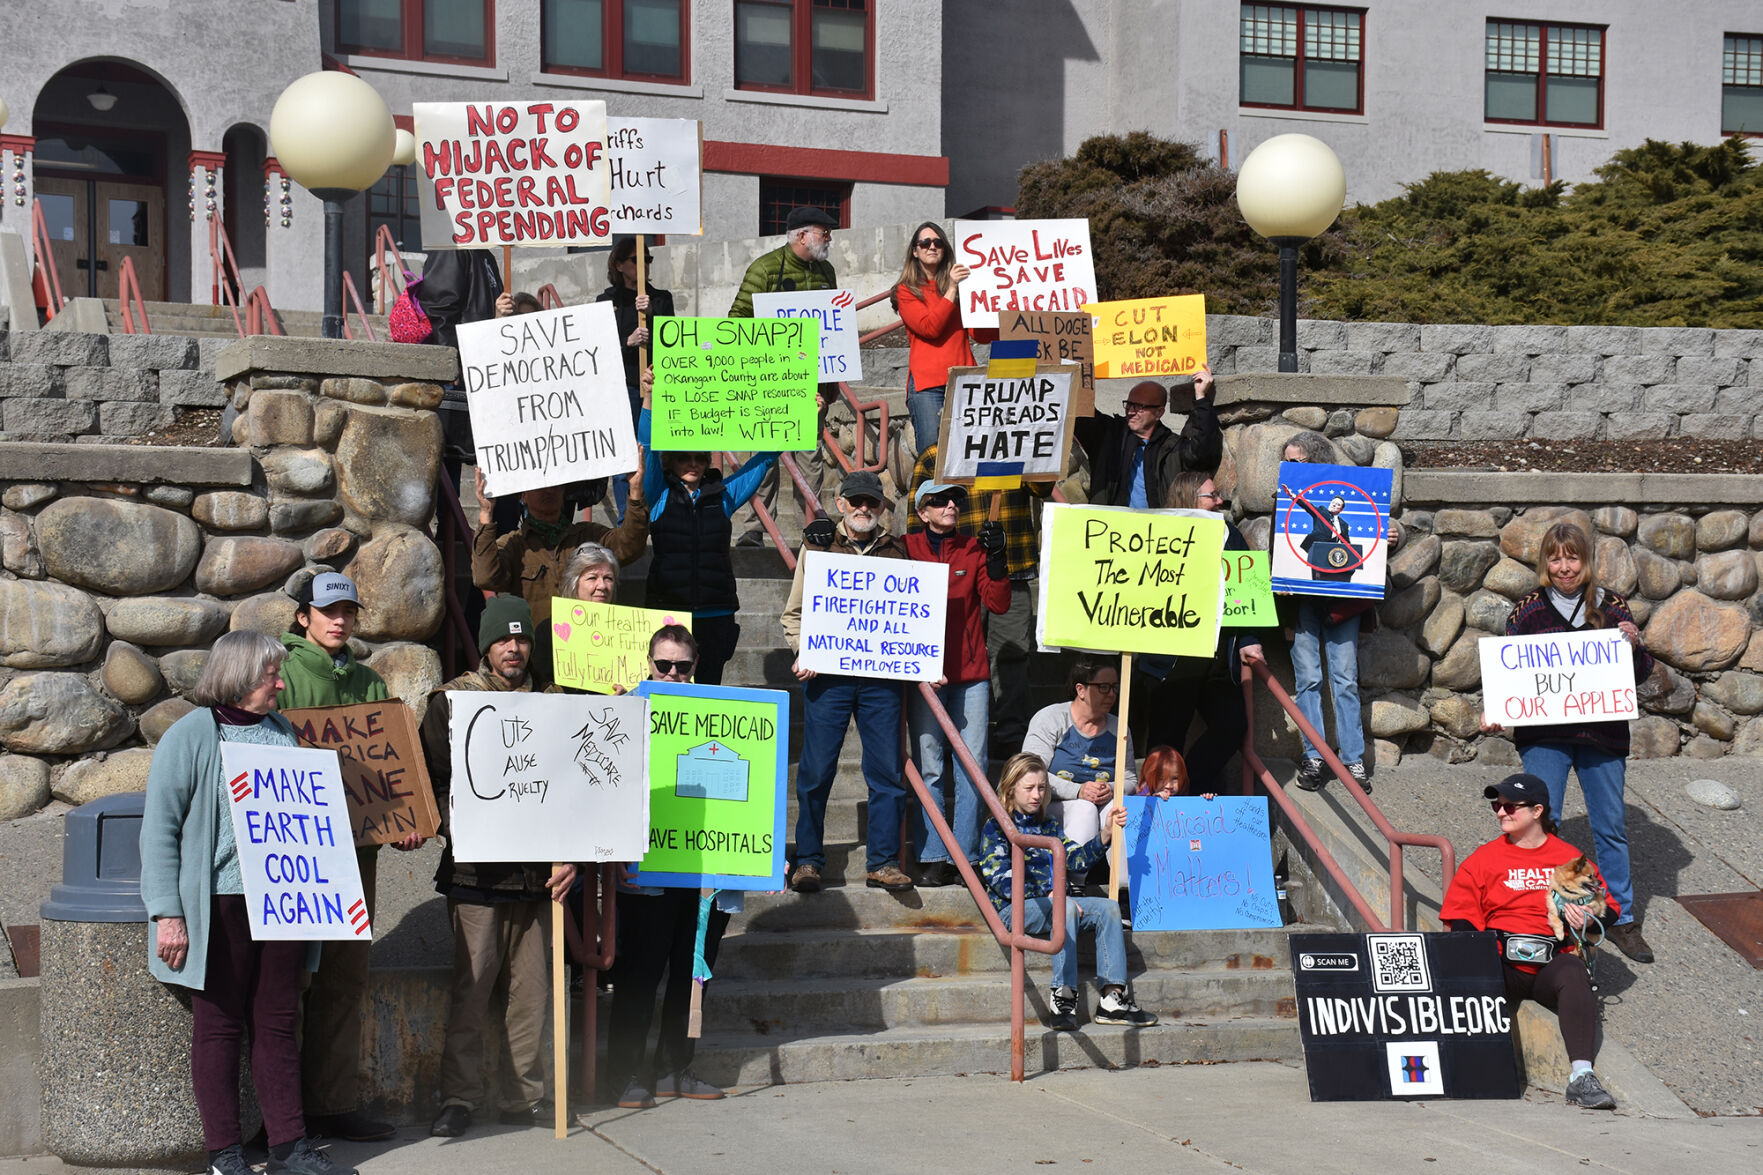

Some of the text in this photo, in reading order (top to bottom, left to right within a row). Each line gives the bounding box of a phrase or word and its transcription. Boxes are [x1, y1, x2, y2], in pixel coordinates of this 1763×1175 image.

[466, 103, 580, 137] NO TO
[607, 128, 644, 149] riffs
[423, 138, 603, 179] HIJACK OF
[609, 157, 666, 190] Hurt
[434, 174, 589, 211] FEDERAL
[452, 206, 610, 244] SPENDING
[611, 204, 672, 221] rchards
[993, 262, 1065, 290] SAVE
[1011, 313, 1090, 335] ALL DOGE
[1115, 305, 1168, 327] CUT
[500, 315, 580, 356] SAVE
[659, 319, 698, 348] OH
[716, 320, 803, 348] SNAP?!
[1112, 325, 1178, 346] ELON
[661, 352, 791, 369] OVER 9,000 people in
[1059, 338, 1084, 360] BE
[1135, 345, 1166, 358] NOT
[467, 346, 598, 393] DEMOCRACY
[720, 369, 757, 387] County
[760, 373, 779, 382] are
[781, 369, 810, 381] about
[1121, 356, 1196, 375] MEDICAID
[517, 389, 584, 423] FROM
[662, 388, 807, 403] to LOSE SNAP resources
[962, 378, 1055, 406] TRUMP
[668, 409, 681, 420] IF
[690, 407, 736, 423] Budget
[739, 407, 751, 417] is
[963, 403, 1060, 427] SPREADS
[670, 420, 801, 442] into law! WTF?!
[964, 430, 1055, 460] HATE
[478, 424, 616, 476] TRUMP/PUTIN
[326, 582, 350, 591] SINIXT
[827, 568, 920, 594] KEEP OUR
[1095, 558, 1185, 587] The Most
[571, 604, 600, 627] Our
[813, 595, 930, 618] FIREFIGHTERS
[1077, 591, 1201, 629] Vulnerable
[847, 617, 911, 635] AND ALL
[591, 631, 649, 651] Our Futur
[808, 635, 940, 658] NATURAL RESOURCE
[556, 648, 585, 687] Fully
[587, 653, 613, 683] Fund
[839, 657, 921, 674] EMPLOYEES
[1501, 642, 1563, 670] CHINA
[1535, 672, 1576, 695] BUY
[1505, 688, 1634, 720] OUR APPLES
[291, 711, 384, 746] MAKE
[589, 707, 630, 755] SAVE
[650, 711, 774, 741] SAVE MEDICAID
[340, 741, 400, 766] RICA
[571, 723, 622, 787] MEDICARE
[254, 768, 329, 807] MAKE
[342, 768, 414, 807] ANE
[246, 811, 335, 847] EARTH
[1147, 799, 1235, 846] Medicaid
[649, 828, 772, 854] AVE HOSPITALS
[265, 853, 329, 884] COOL
[1154, 847, 1254, 900] Matters!
[264, 892, 344, 926] AGAIN
[1317, 957, 1350, 966] SCAN ME
